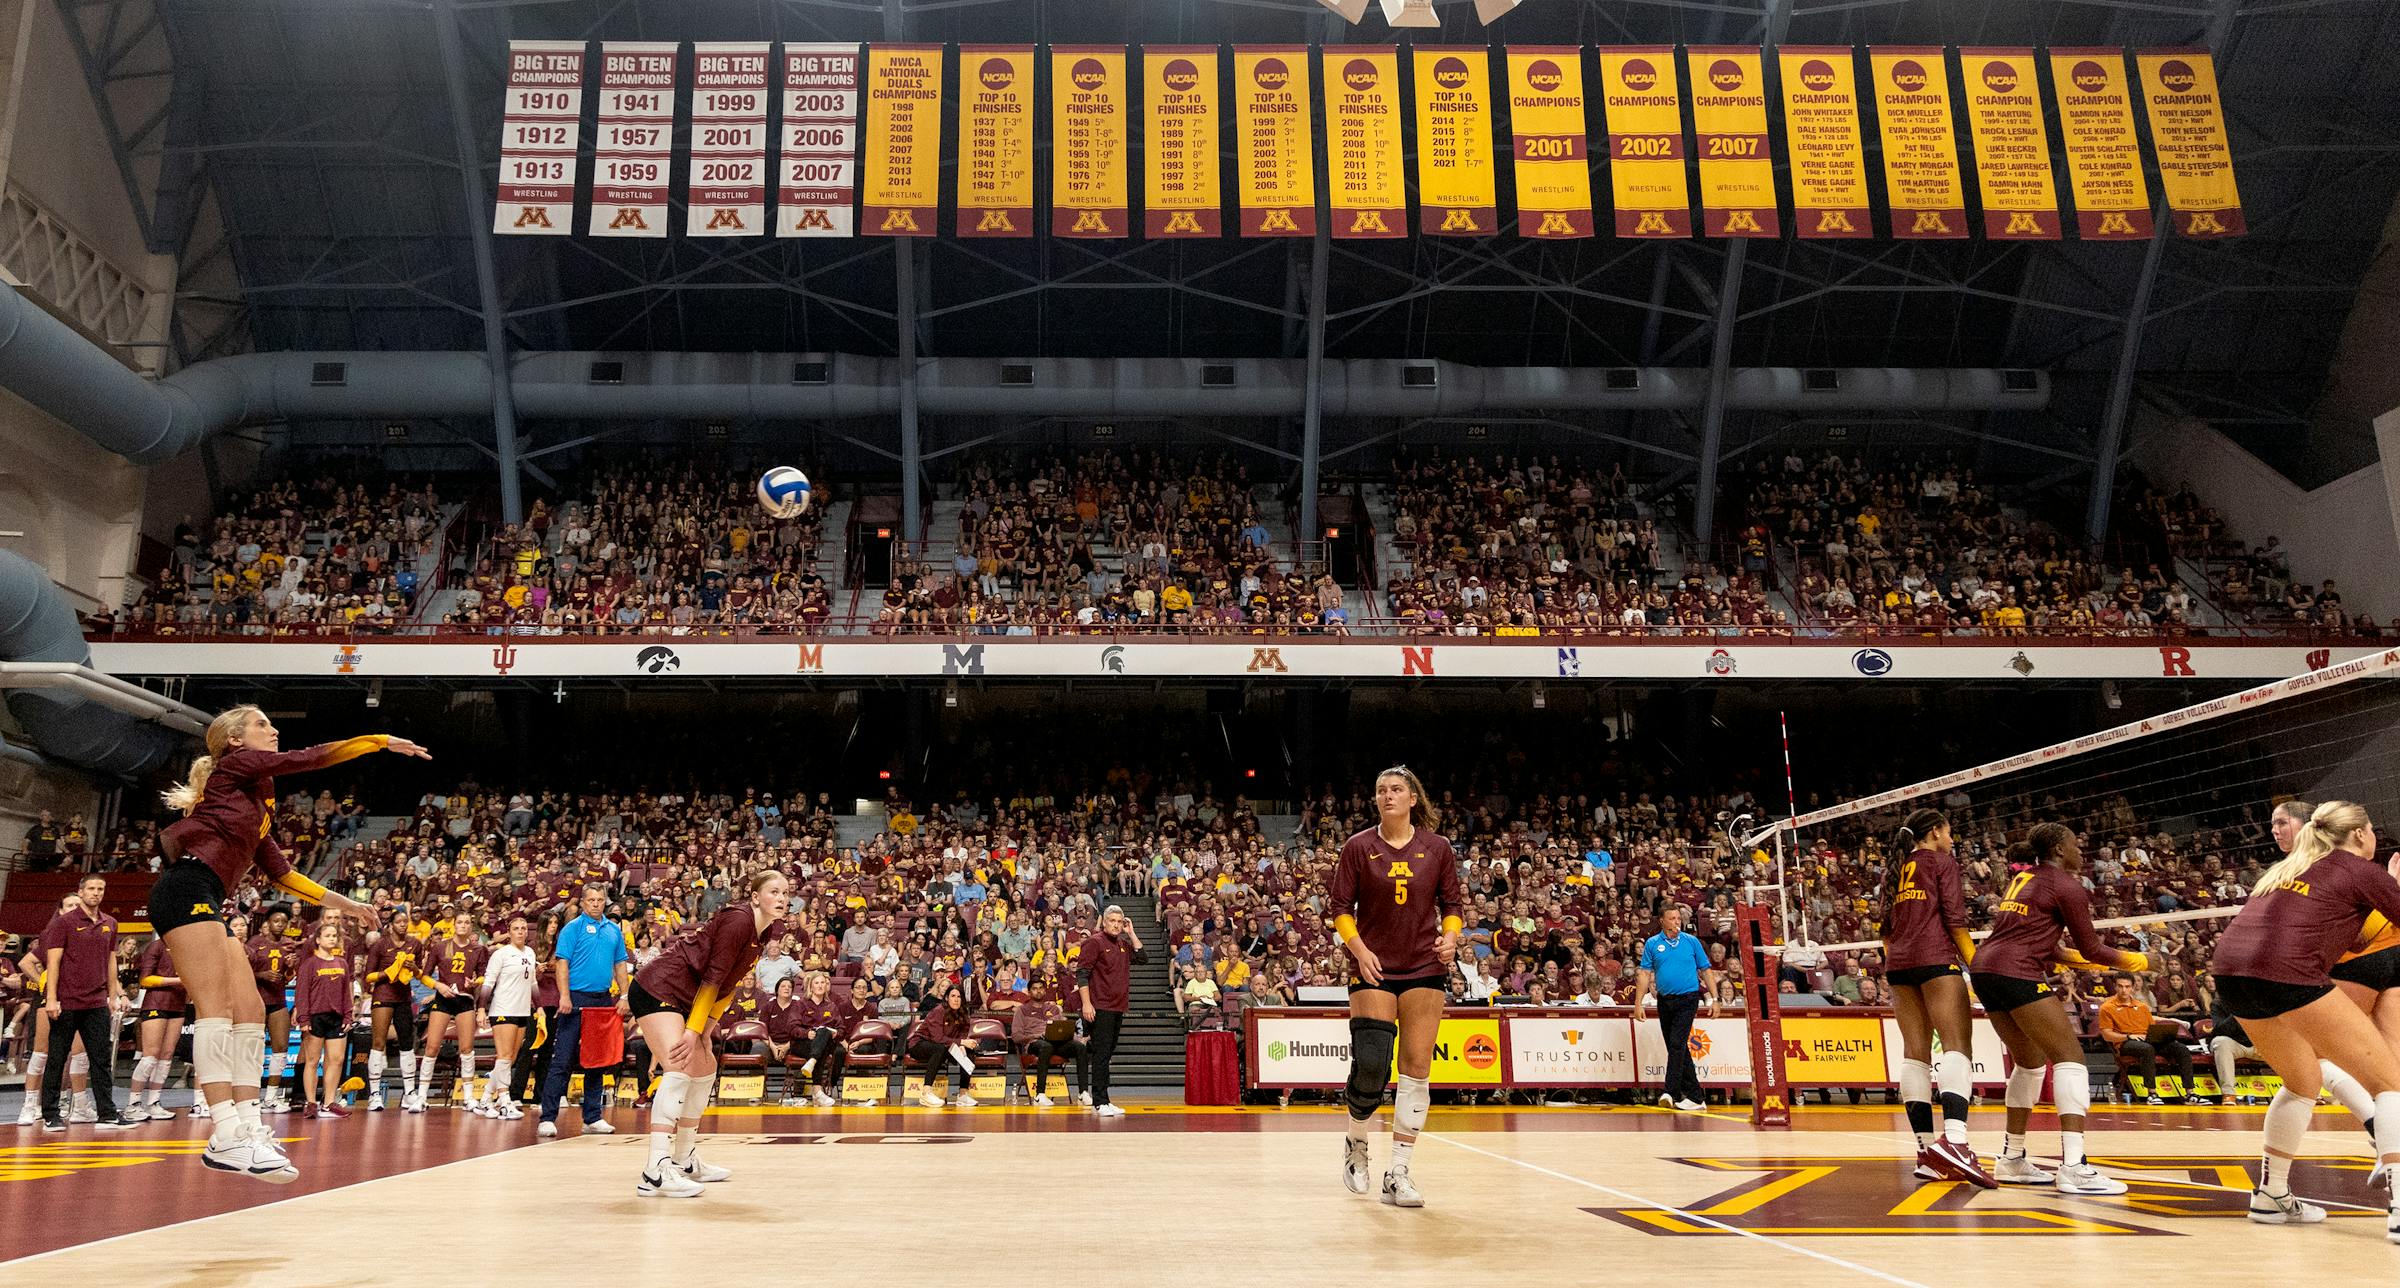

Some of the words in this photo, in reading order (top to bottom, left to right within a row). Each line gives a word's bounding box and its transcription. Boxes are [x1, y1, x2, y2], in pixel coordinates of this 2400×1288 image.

[514, 55, 544, 70] BIG
[547, 56, 579, 70] TEN
[607, 56, 635, 72] BIG
[638, 57, 671, 72] TEN
[700, 57, 729, 72] BIG
[732, 57, 764, 72] TEN
[789, 57, 818, 72] BIG
[821, 57, 854, 72] TEN
[890, 57, 921, 67] NWCA
[880, 68, 931, 77] NATIONAL
[1437, 72, 1468, 81] NCAA
[512, 72, 579, 84] CHAMPIONS
[605, 73, 671, 85] CHAMPIONS
[698, 73, 764, 85] CHAMPIONS
[788, 73, 854, 85] CHAMPIONS
[983, 73, 1013, 82] NCAA
[1075, 74, 1105, 83] NCAA
[1166, 75, 1197, 83] NCAA
[1257, 73, 1288, 82] NCAA
[1347, 74, 1377, 83] NCAA
[1531, 75, 1562, 84] NCAA
[1625, 74, 1656, 83] NCAA
[1712, 75, 1743, 83] NCAA
[1804, 75, 1835, 83] NCAA
[2164, 76, 2194, 84] NCAA
[888, 79, 922, 88] DUALS
[873, 90, 936, 99] CHAMPIONS
[979, 93, 1000, 103] TOP
[1003, 93, 1016, 102] 10
[1072, 94, 1092, 103] TOP
[1095, 94, 1108, 103] 10
[1163, 95, 1185, 103] TOP
[1188, 95, 1200, 103] 10
[1255, 93, 1275, 102] TOP
[1278, 93, 1292, 102] 10
[1344, 94, 1365, 103] TOP
[1368, 94, 1381, 103] 10
[1435, 92, 1455, 101] TOP
[1459, 92, 1472, 101] 10
[1792, 94, 1849, 103] CHAMPION
[520, 93, 569, 109] 1910
[612, 94, 659, 111] 1941
[706, 94, 755, 111] 1999
[795, 94, 844, 111] 2003
[1514, 97, 1581, 107] CHAMPIONS
[1609, 96, 1676, 106] CHAMPIONS
[1697, 96, 1763, 106] CHAMPIONS
[1885, 95, 1941, 104] CHAMPION
[1976, 96, 2032, 105] CHAMPION
[2066, 95, 2122, 105] CHAMPION
[2154, 95, 2212, 105] CHAMPION
[892, 103, 913, 111] 1998
[973, 104, 1021, 113] FINISHES
[1067, 104, 1114, 113] FINISHES
[1158, 105, 1207, 114] FINISHES
[1250, 103, 1298, 113] FINISHES
[1339, 105, 1387, 114] FINISHES
[1430, 103, 1478, 112] FINISHES
[974, 118, 995, 126] 1937
[1161, 119, 1183, 127] 1979
[1253, 118, 1275, 126] 1999
[1342, 119, 1364, 127] 2006
[1432, 117, 1454, 125] 2014
[890, 124, 913, 132] 2002
[516, 127, 566, 143] 1912
[610, 128, 659, 145] 1957
[704, 129, 752, 145] 2001
[793, 129, 843, 146] 2006
[890, 135, 912, 143] 2006
[1161, 140, 1183, 148] 1990
[1253, 139, 1275, 147] 2001
[1343, 140, 1365, 148] 2008
[1433, 138, 1455, 146] 2017
[1709, 138, 1758, 155] 2007
[890, 145, 912, 153] 2007
[1525, 139, 1573, 157] 2001
[1621, 138, 1671, 156] 2002
[973, 150, 995, 158] 1940
[1161, 151, 1183, 159] 1991
[1254, 150, 1276, 158] 2002
[1433, 149, 1456, 157] 2019
[889, 156, 912, 164] 2012
[1344, 161, 1365, 169] 2011
[513, 162, 563, 179] 1913
[608, 163, 658, 180] 1959
[702, 164, 752, 181] 2002
[792, 164, 842, 181] 2007
[889, 167, 911, 175] 2013
[973, 171, 995, 179] 1947
[1255, 171, 1277, 179] 2004
[1161, 172, 1183, 180] 1997
[1344, 172, 1367, 180] 2012
[1161, 183, 1184, 191] 1998
[513, 189, 558, 198] WRESTLING
[608, 190, 652, 199] WRESTLING
[704, 191, 749, 199] WRESTLING
[794, 191, 838, 200] WRESTLING
[799, 645, 824, 669] M
[942, 644, 984, 674] M
[1247, 648, 1288, 672] M
[1402, 647, 1434, 674] N
[2160, 647, 2196, 676] R
[2306, 649, 2330, 672] W
[2287, 674, 2319, 691] GOPHER
[2318, 662, 2367, 682] VOLLEYBALL
[2162, 711, 2185, 725] GOPHER
[2187, 700, 2227, 718] VOLLEYBALL
[2004, 872, 2035, 900] 17
[1394, 879, 1408, 905] 5
[452, 960, 464, 973] 22
[1762, 1032, 1772, 1056] sports
[1814, 1040, 1873, 1052] HEALTH
[1524, 1051, 1626, 1062] TRUSTONE
[1815, 1054, 1856, 1062] FAIRVIEW
[1645, 1066, 1665, 1075] sun
[1710, 1064, 1749, 1076] airlines
[1766, 1056, 1775, 1086] imports
[1762, 1096, 1784, 1109] M
